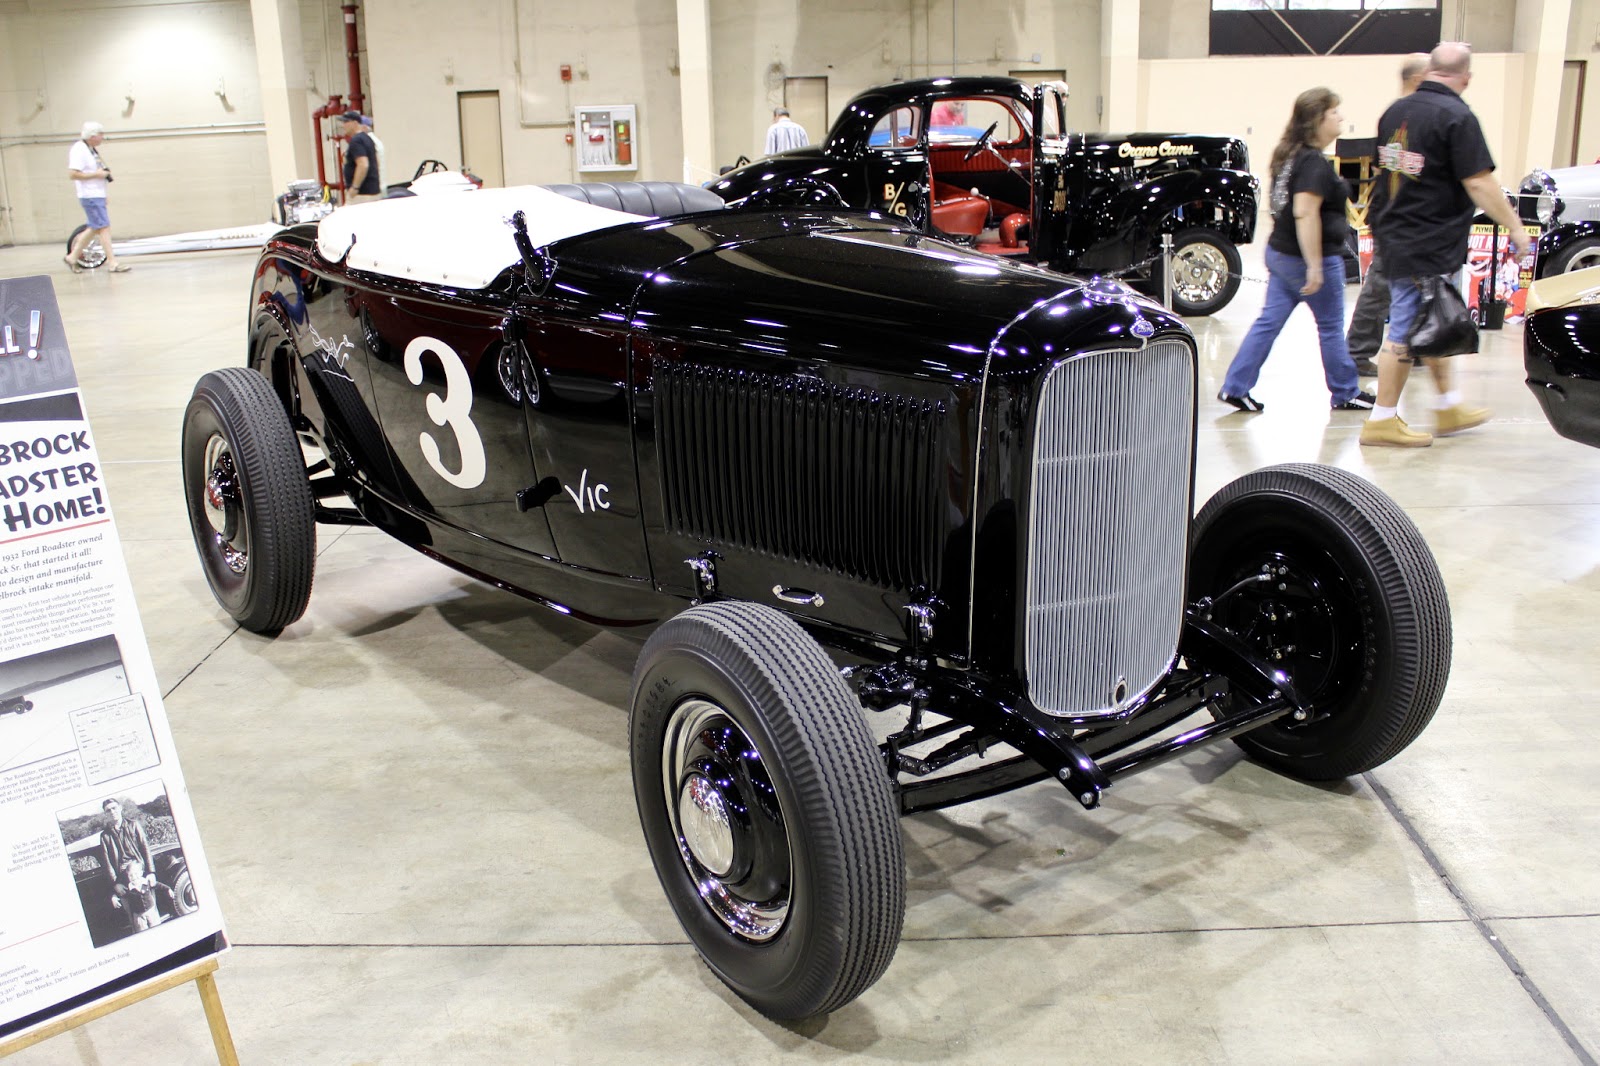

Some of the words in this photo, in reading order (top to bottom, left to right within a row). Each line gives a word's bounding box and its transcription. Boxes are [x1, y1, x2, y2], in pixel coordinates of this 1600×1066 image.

[1118, 142, 1158, 158] Crane
[1159, 140, 1194, 156] Cams
[404, 336, 486, 489] 3
[0, 430, 90, 466] BROCK
[3, 487, 106, 532] HOME!
[2, 554, 19, 562] 1932
[22, 547, 39, 557] Ford
[42, 541, 76, 553] Roadster
[78, 533, 102, 545] owned
[24, 559, 40, 569] that
[42, 553, 69, 565] started
[80, 548, 92, 557] all!
[9, 575, 34, 586] design
[37, 569, 51, 579] and
[54, 560, 103, 575] manufacture
[29, 582, 54, 593] intake
[56, 572, 93, 587] manifold.
